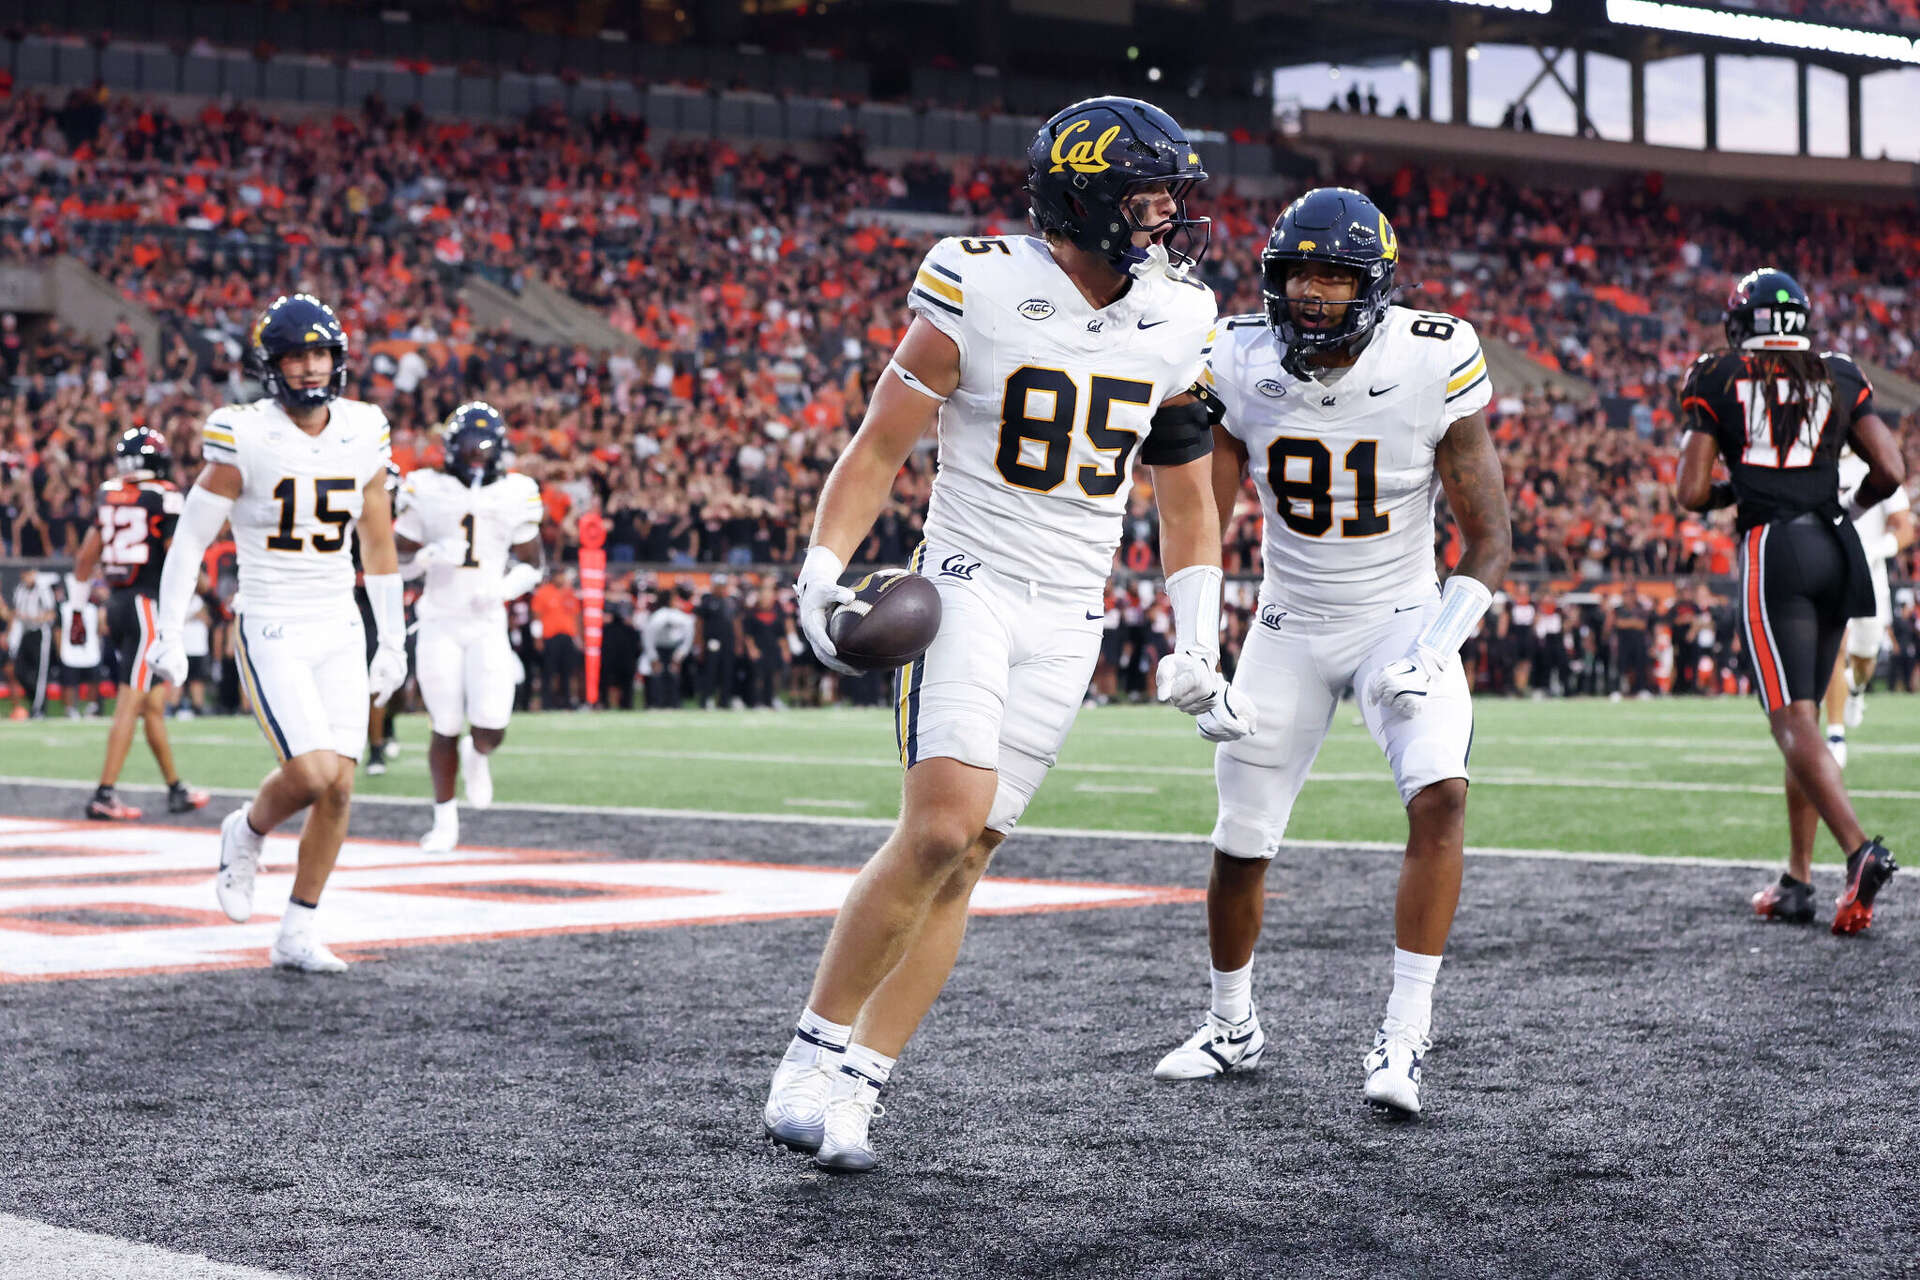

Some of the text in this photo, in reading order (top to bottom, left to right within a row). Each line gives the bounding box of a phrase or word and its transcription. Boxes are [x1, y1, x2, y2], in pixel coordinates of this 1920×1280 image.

[1049, 119, 1121, 174] Cal
[960, 236, 1012, 256] 5
[1024, 304, 1050, 312] ACC
[1773, 311, 1797, 332] 17
[1086, 320, 1104, 333] Cal
[1262, 382, 1282, 393] ACC
[1321, 396, 1336, 406] Cal
[994, 364, 1154, 498] 85
[1736, 378, 1832, 468] 17
[1267, 435, 1390, 538] 81
[267, 477, 356, 553] 15
[460, 513, 480, 568] 1
[938, 554, 982, 581] Cal
[1260, 604, 1287, 631] Cal
